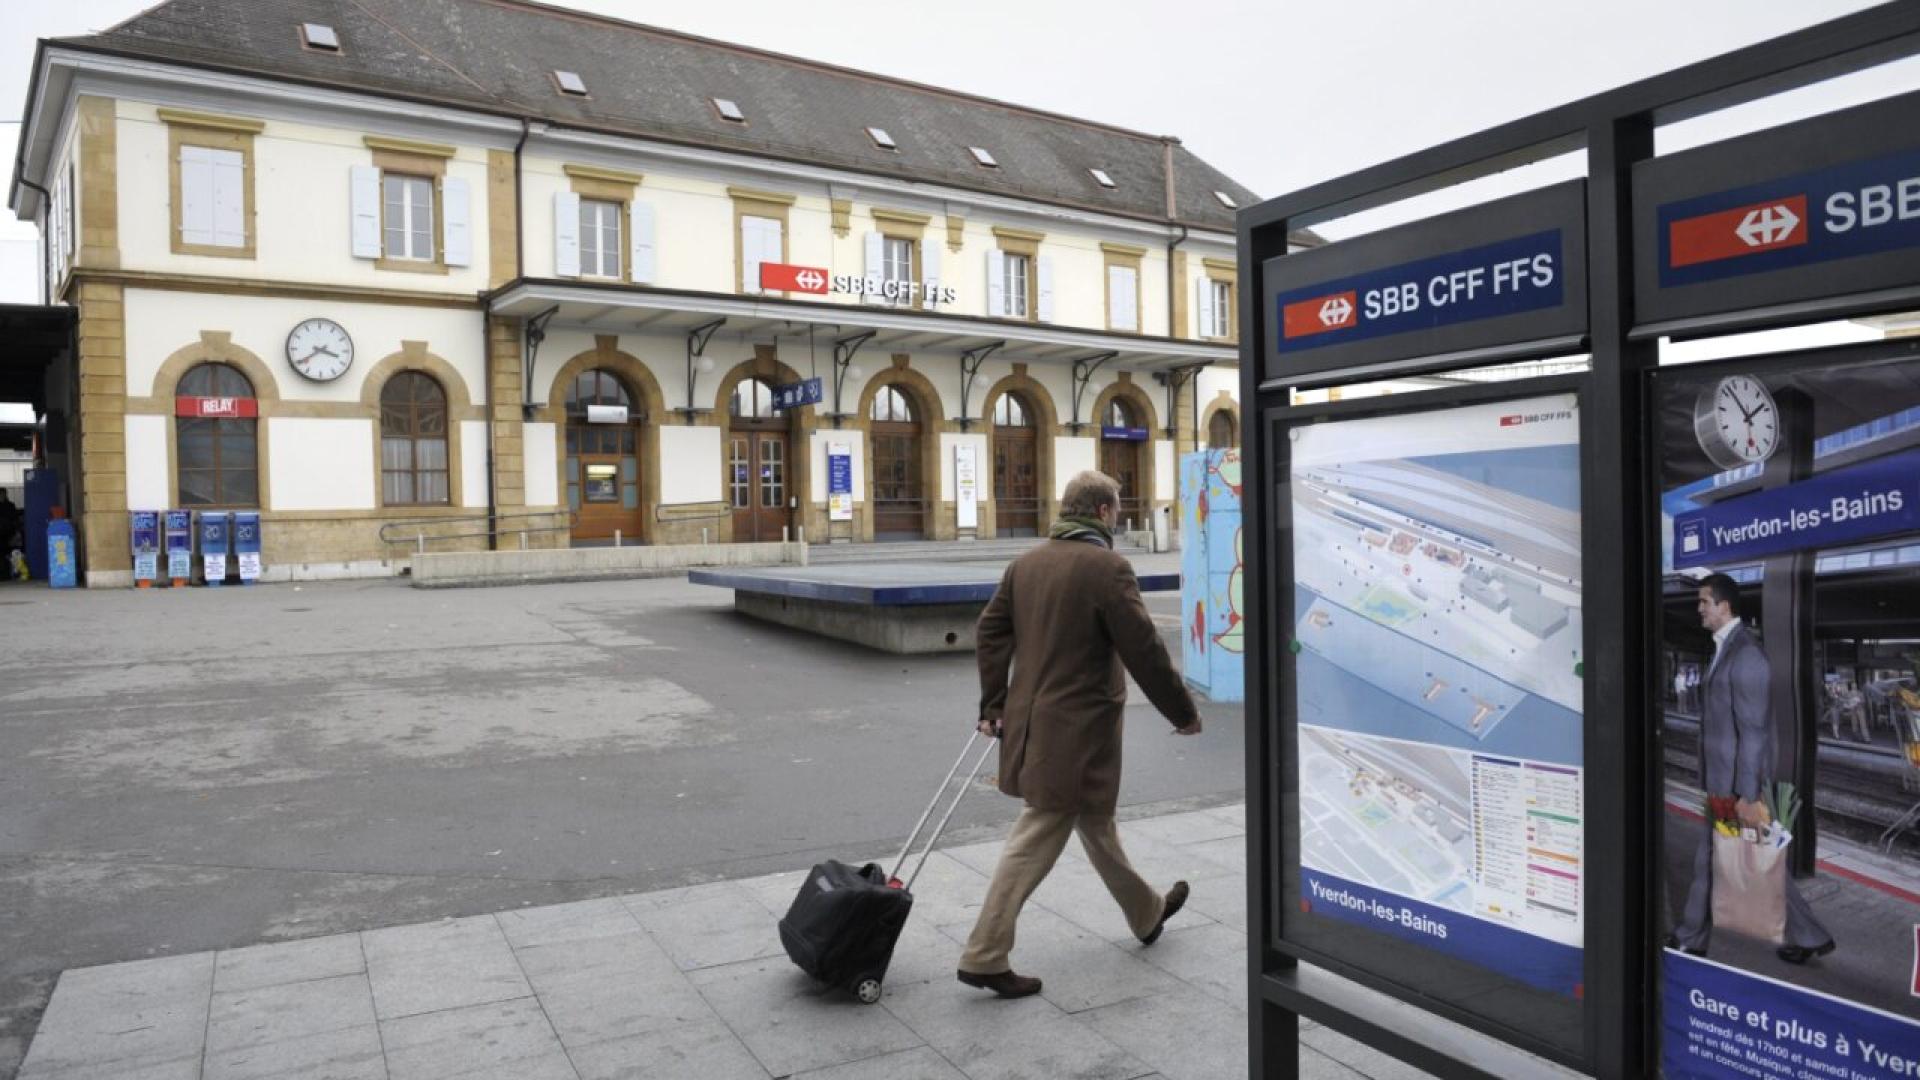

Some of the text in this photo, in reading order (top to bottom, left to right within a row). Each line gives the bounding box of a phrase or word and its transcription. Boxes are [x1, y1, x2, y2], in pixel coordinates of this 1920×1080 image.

[834, 275, 877, 295] SBB
[882, 280, 920, 299] CFF
[1364, 253, 1553, 319] SBB CFF FFS
[203, 398, 233, 413] RELAY
[1712, 489, 1904, 547] Yverdon-les-Bains
[1310, 879, 1448, 939] Yverdon-les-Bains
[1688, 1015, 1734, 1040] Vendredi
[1734, 1032, 1754, 1047] dès
[1757, 1039, 1789, 1060] 17h00
[1790, 1053, 1802, 1064] et
[1805, 1057, 1849, 1079] samedi
[1689, 989, 1920, 1078] Gare et plus à Yver
[1715, 1054, 1762, 1079] concours
